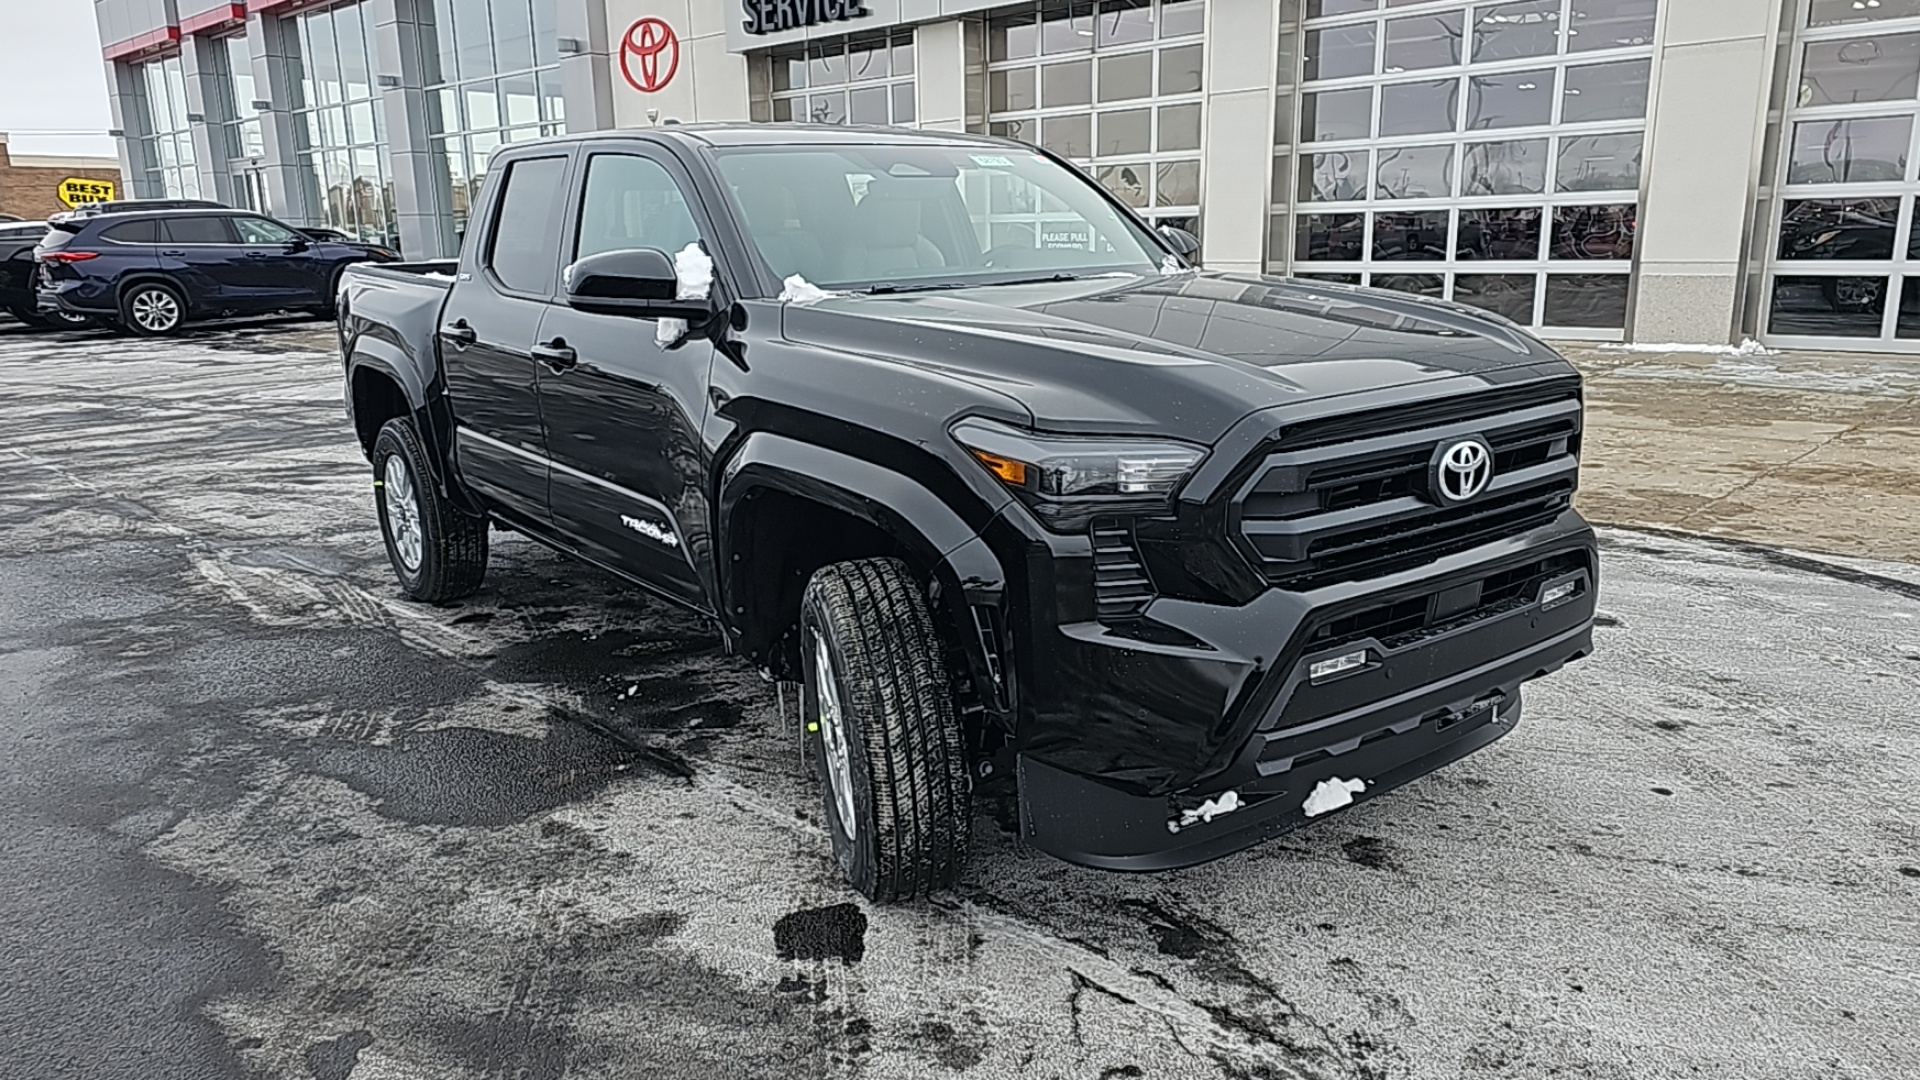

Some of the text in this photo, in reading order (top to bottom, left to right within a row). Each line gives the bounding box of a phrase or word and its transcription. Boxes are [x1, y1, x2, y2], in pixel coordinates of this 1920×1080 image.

[66, 183, 111, 196] BEST
[1042, 232, 1088, 242] PLEASE PULL
